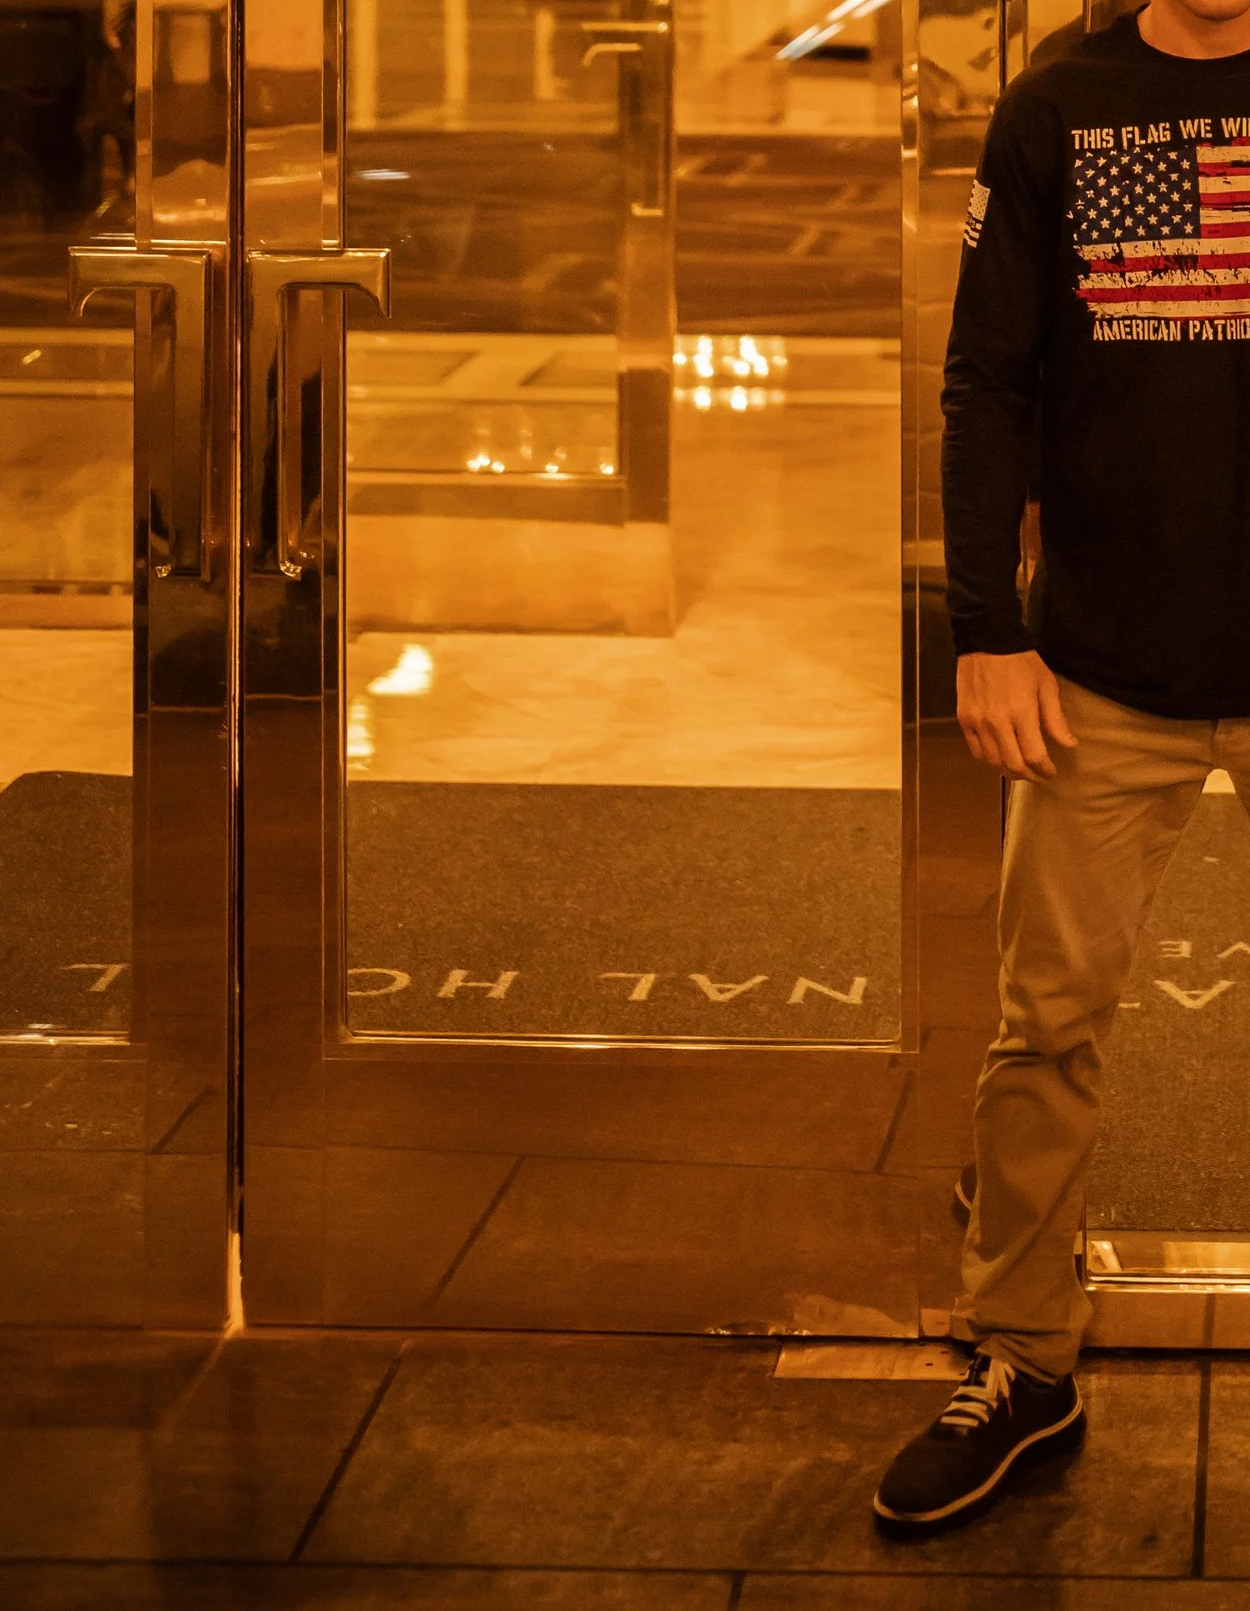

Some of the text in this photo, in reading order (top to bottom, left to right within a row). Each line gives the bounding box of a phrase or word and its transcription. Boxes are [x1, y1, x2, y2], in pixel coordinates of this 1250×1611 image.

[1070, 128, 1115, 150] THIS
[1121, 121, 1172, 150] FLAG
[1179, 118, 1213, 140] WE
[1092, 318, 1182, 342] AMERICAN
